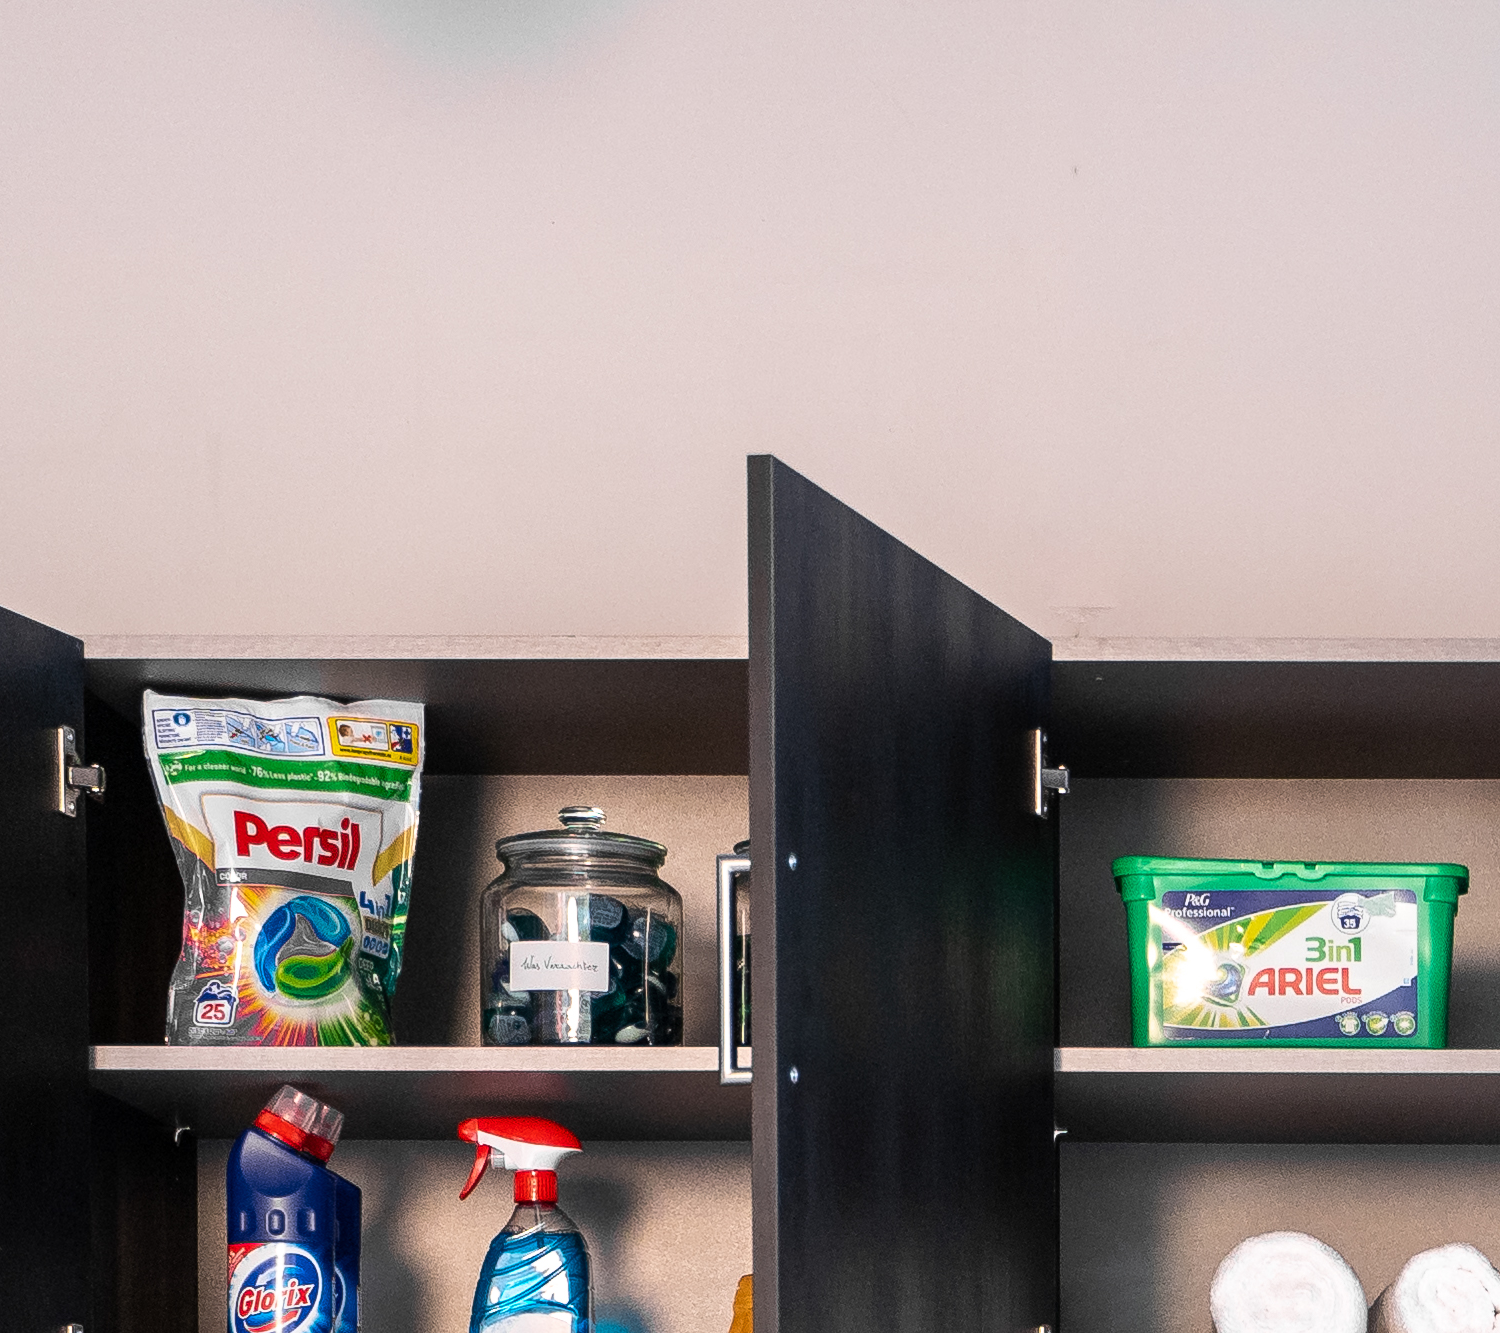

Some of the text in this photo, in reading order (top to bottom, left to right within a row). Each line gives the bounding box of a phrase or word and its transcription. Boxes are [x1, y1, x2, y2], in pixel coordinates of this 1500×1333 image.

[233, 810, 362, 871] Persil
[1185, 893, 1211, 906] P&G
[1344, 919, 1357, 930] 35
[1305, 936, 1363, 963] 3in1
[1247, 967, 1363, 996] ARIEL
[1341, 996, 1363, 1004] PODS
[200, 1003, 226, 1021] 25
